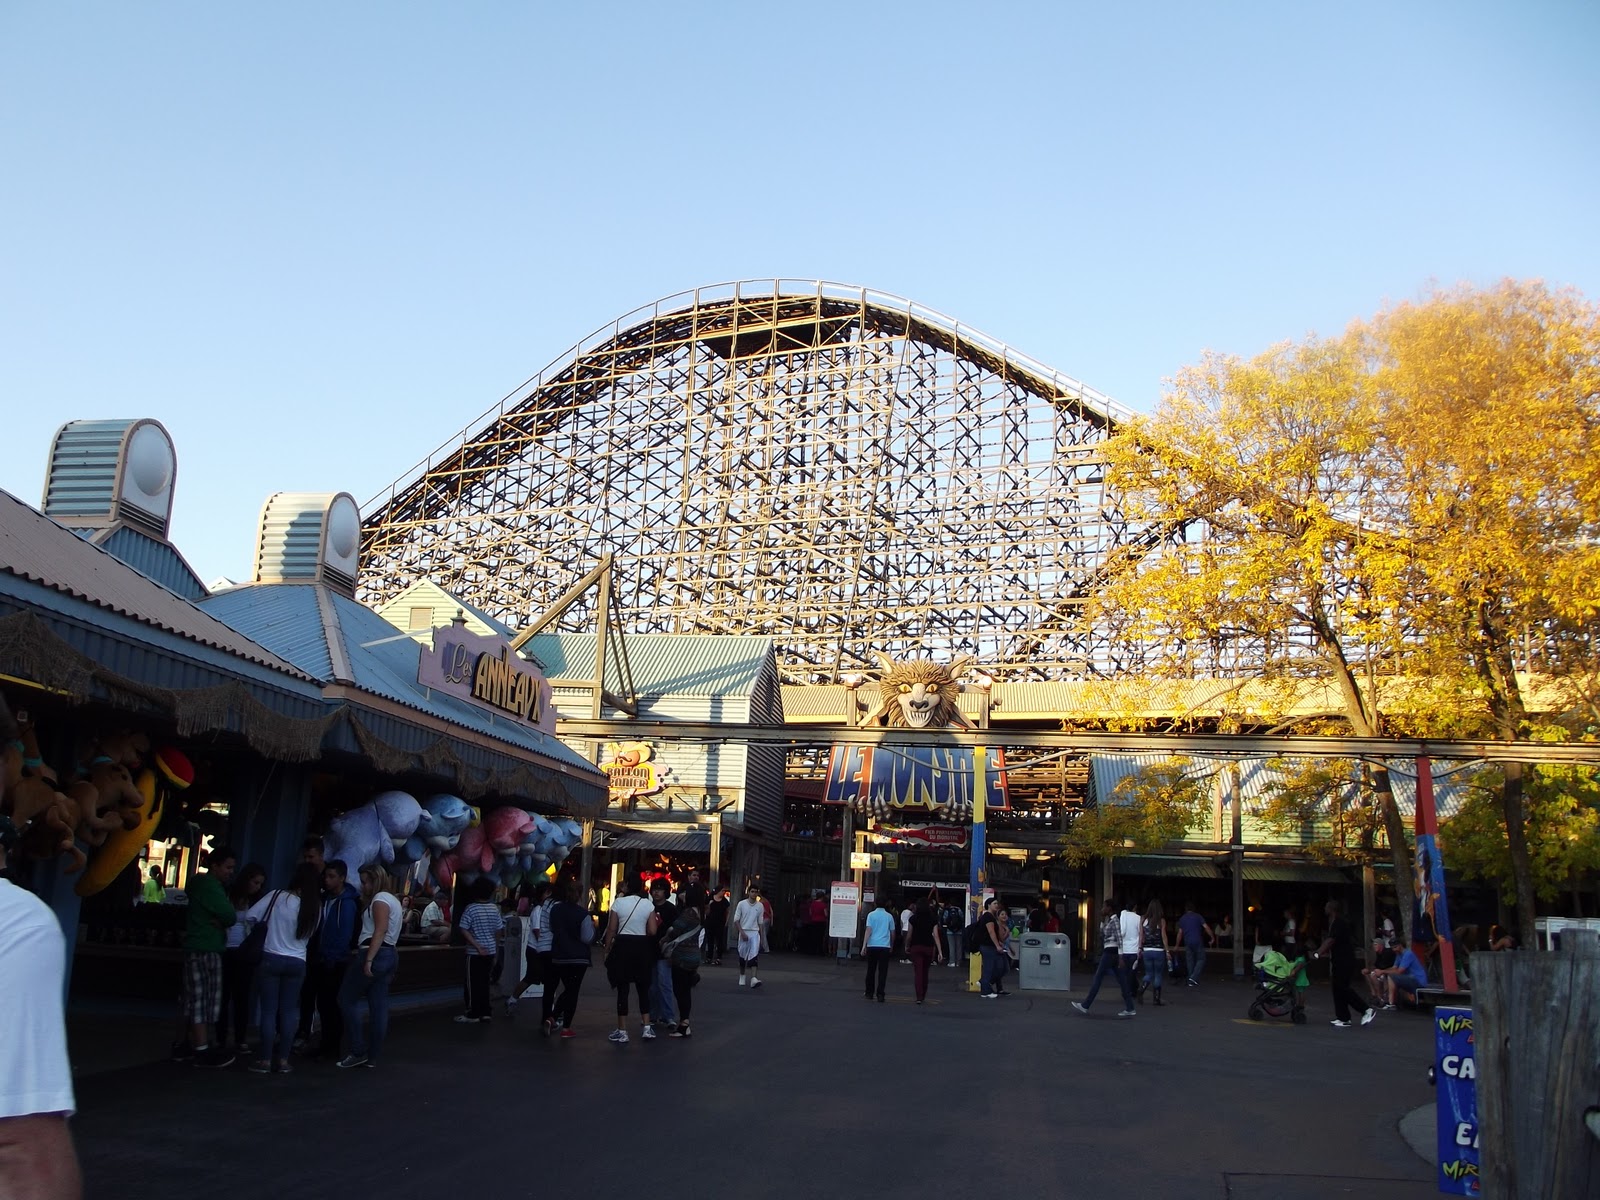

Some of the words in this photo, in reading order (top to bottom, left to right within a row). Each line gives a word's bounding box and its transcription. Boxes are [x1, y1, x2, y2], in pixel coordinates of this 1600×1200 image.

[445, 643, 472, 684] Les
[472, 647, 542, 722] ANNEAUX
[826, 746, 868, 801] LE
